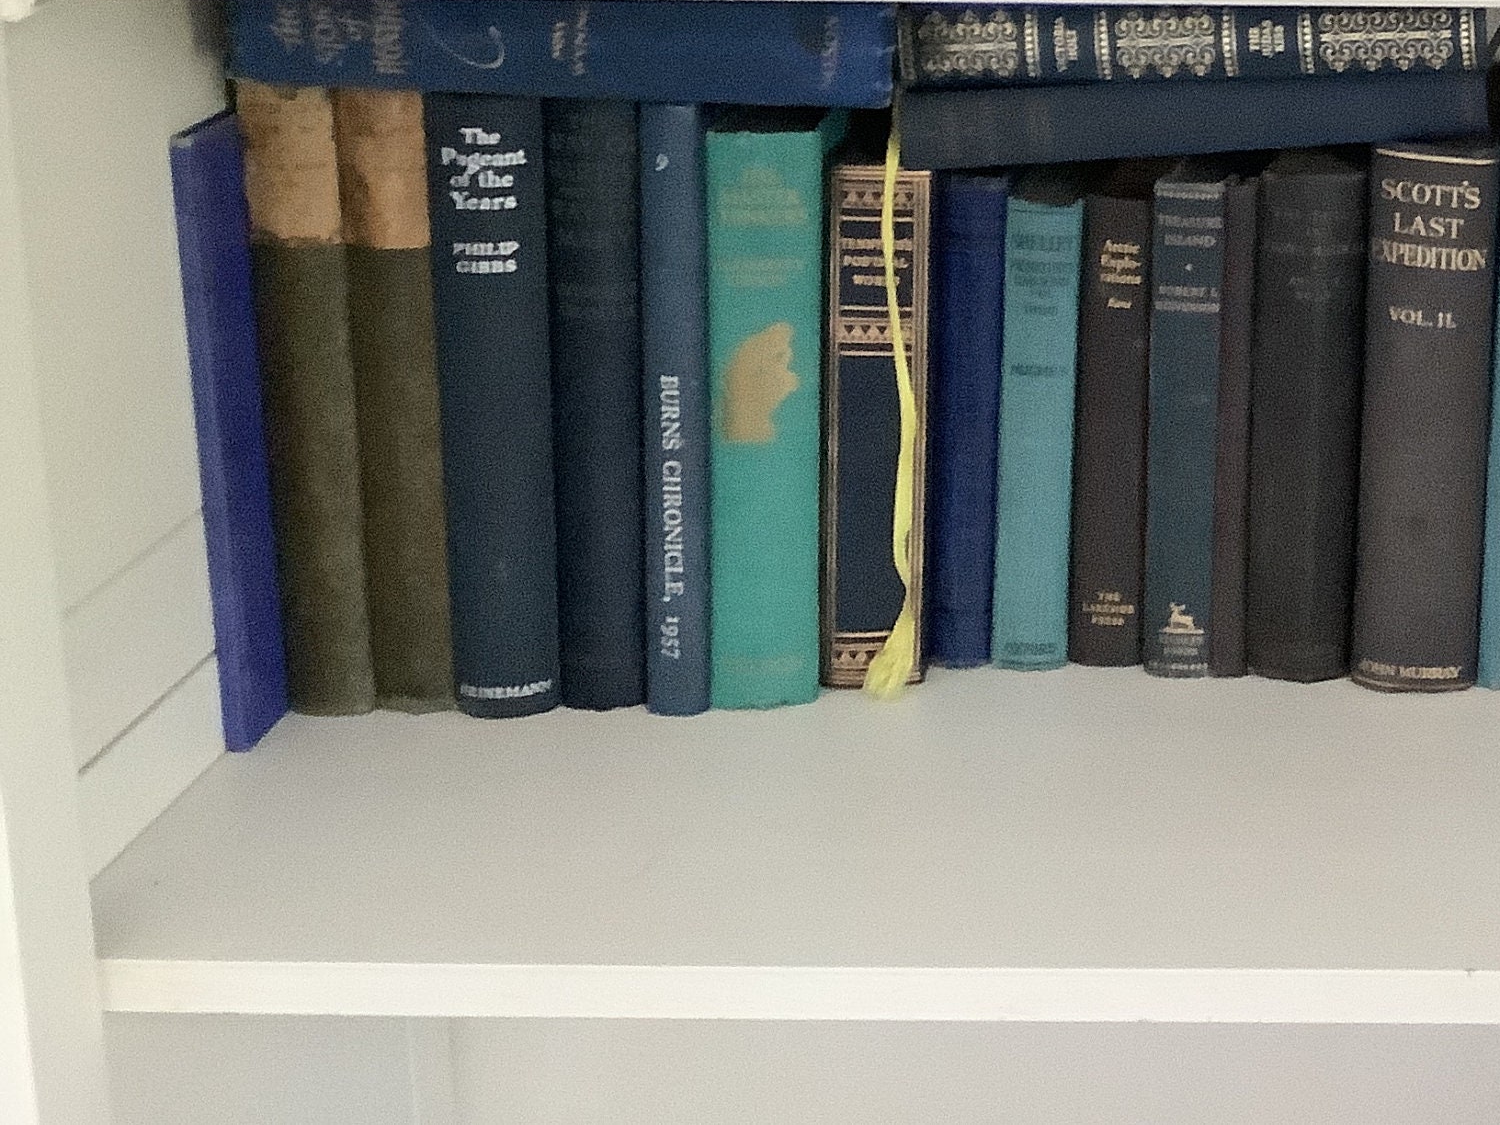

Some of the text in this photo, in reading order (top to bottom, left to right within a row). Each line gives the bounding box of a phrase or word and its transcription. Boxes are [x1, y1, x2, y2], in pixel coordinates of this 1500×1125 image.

[458, 126, 501, 146] The
[477, 170, 515, 189] the
[1380, 178, 1482, 210] SCOTT'S
[449, 191, 519, 211] Years
[1392, 211, 1465, 240] LAST
[1371, 236, 1489, 272] EXPEDITION
[1387, 304, 1434, 328] VOL.
[659, 374, 682, 451] BURNS
[659, 615, 681, 661] 1957
